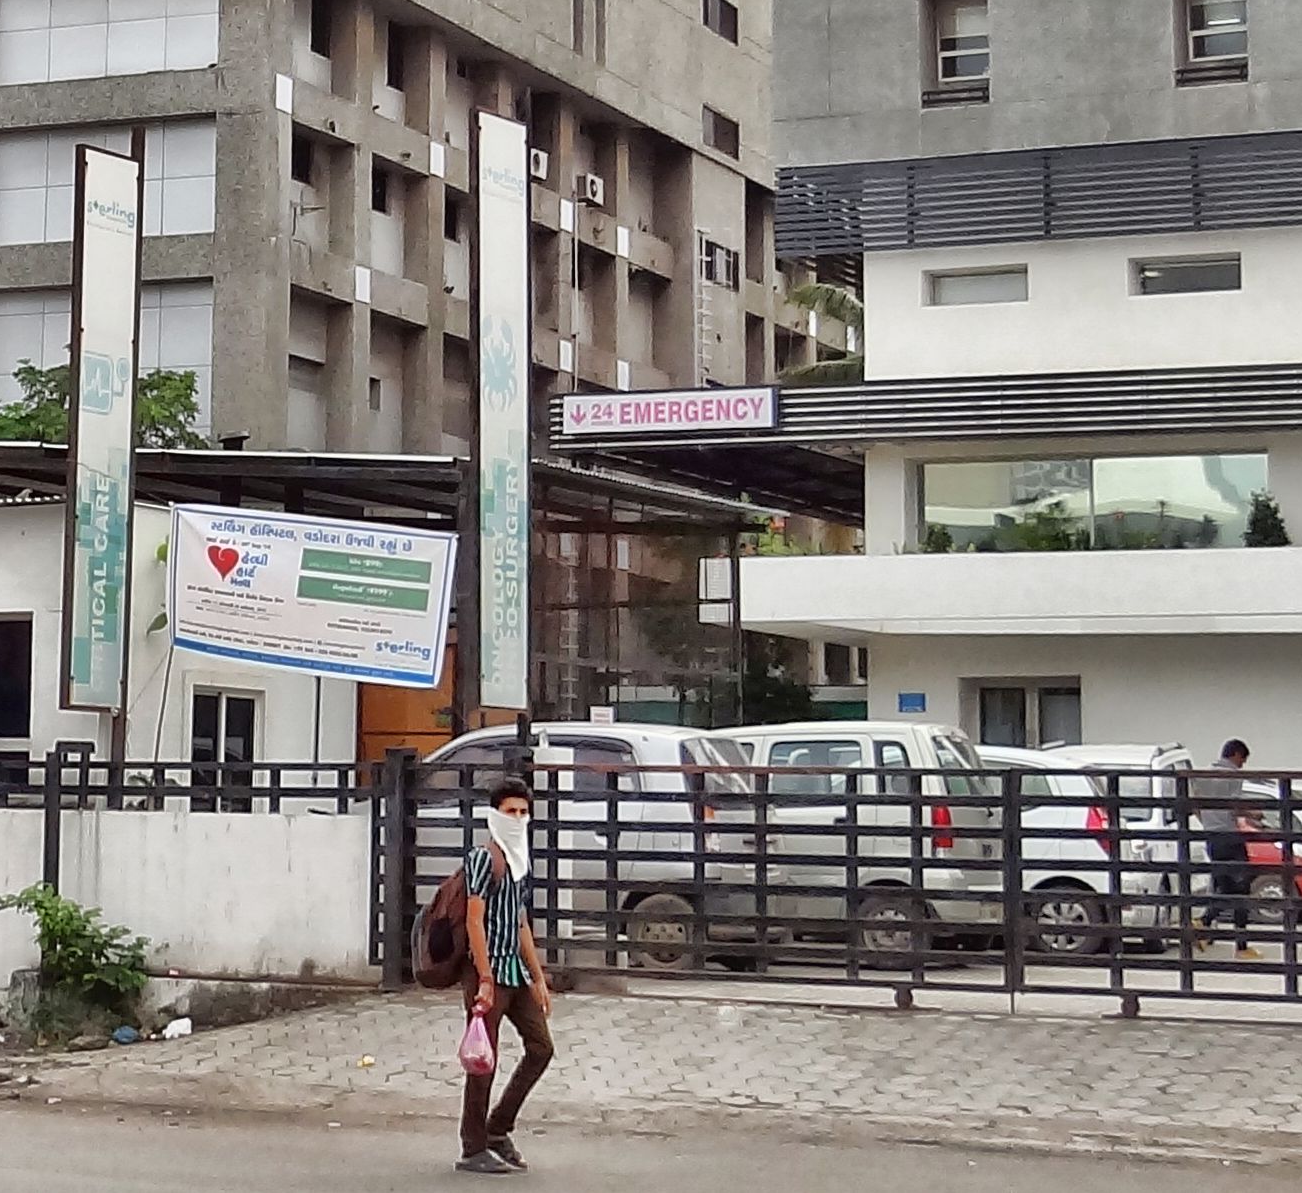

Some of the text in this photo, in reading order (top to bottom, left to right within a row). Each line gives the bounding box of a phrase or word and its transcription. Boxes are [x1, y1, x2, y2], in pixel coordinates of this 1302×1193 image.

[87, 200, 135, 228] sterling
[591, 397, 764, 424] 24 EMERGENCY
[93, 473, 111, 551] CARE
[376, 641, 431, 660] sterling
